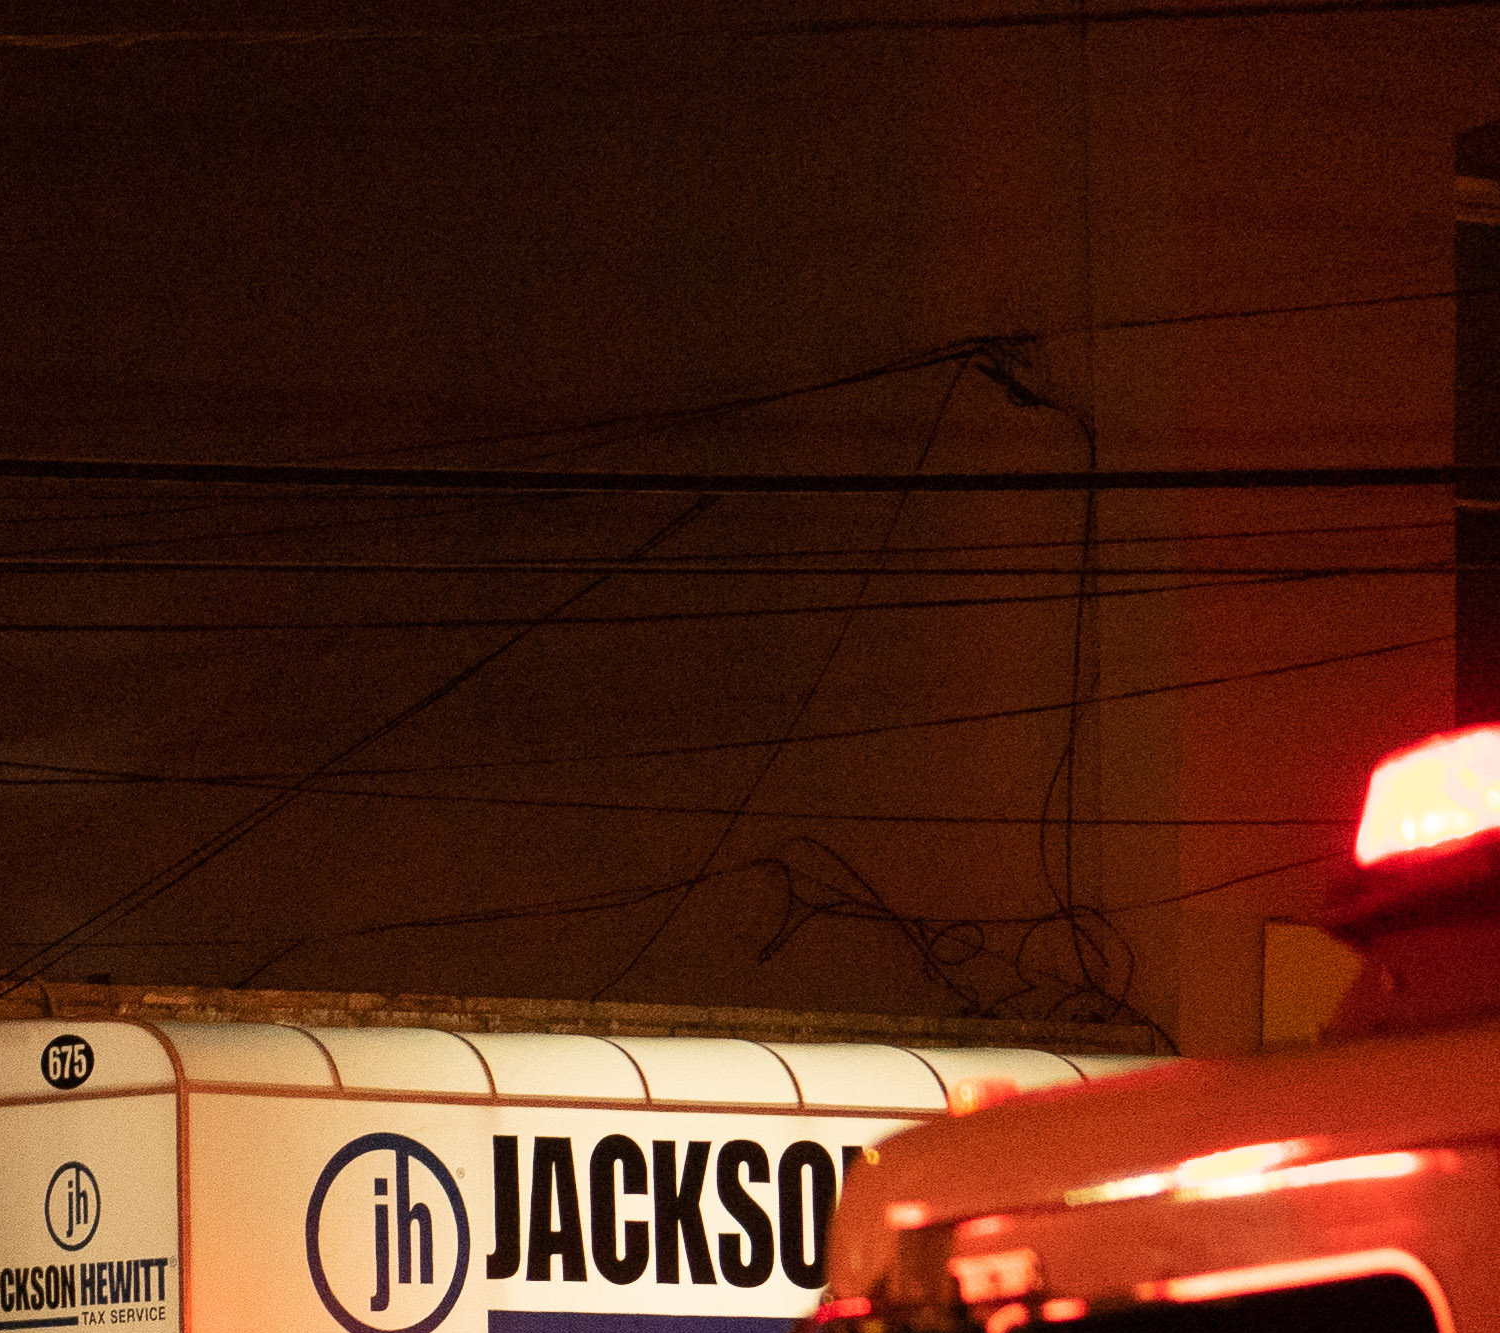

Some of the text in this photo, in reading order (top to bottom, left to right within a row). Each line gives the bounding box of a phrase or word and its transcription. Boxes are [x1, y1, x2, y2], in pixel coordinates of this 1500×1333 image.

[48, 1045, 88, 1081] 675
[486, 1133, 864, 1290] JACKSO
[79, 1257, 168, 1308] HEWITT
[81, 1306, 167, 1327] TAX SERVICE
